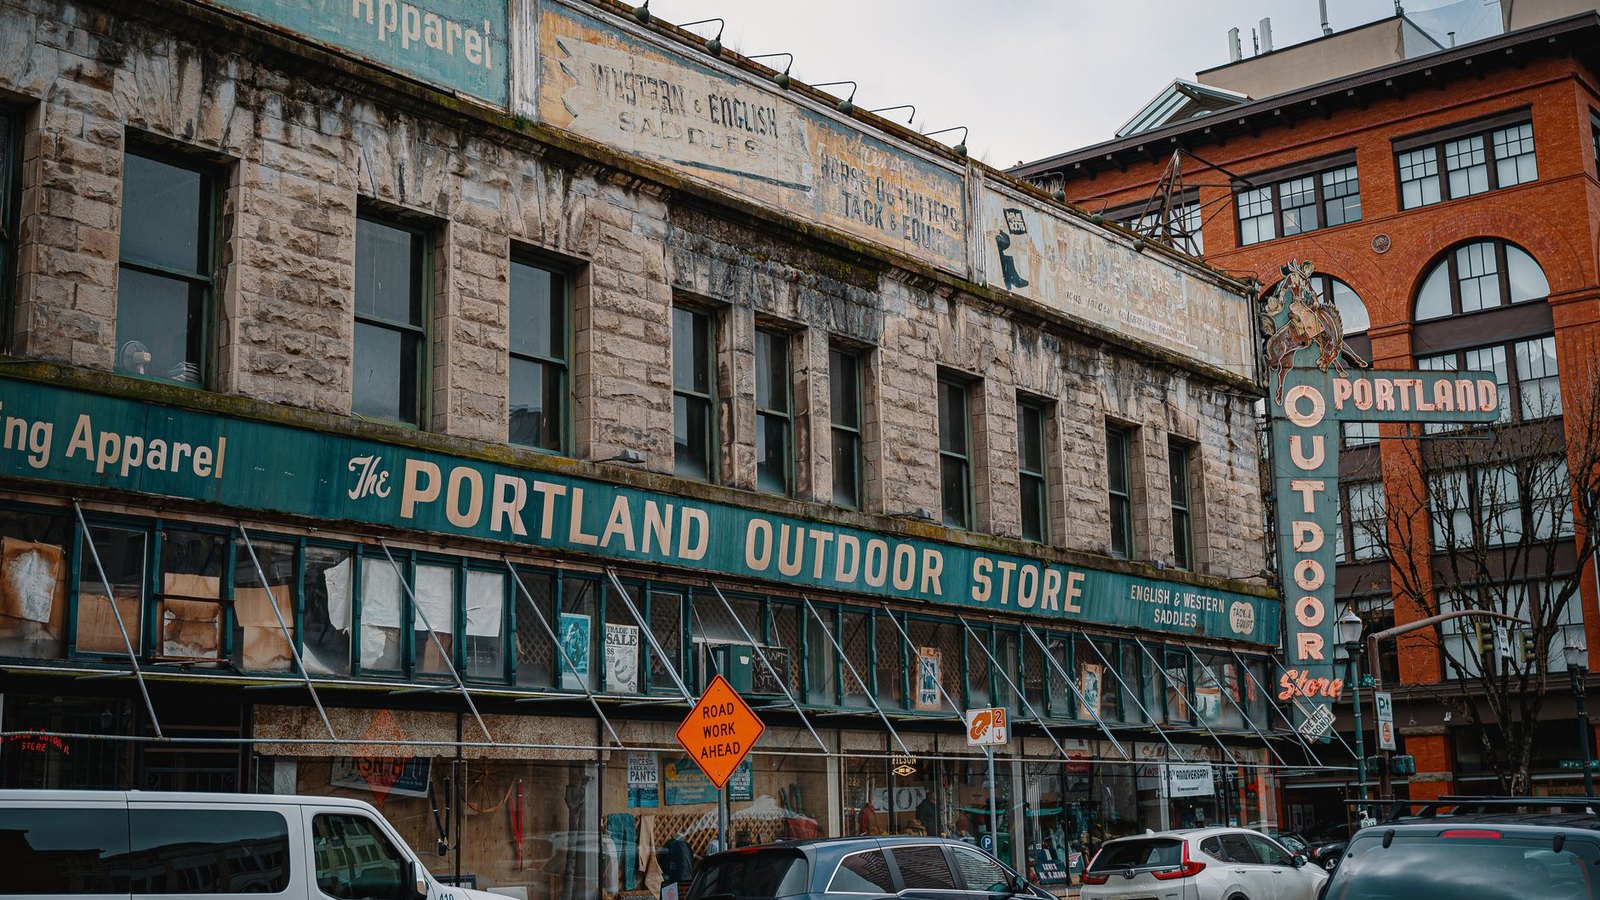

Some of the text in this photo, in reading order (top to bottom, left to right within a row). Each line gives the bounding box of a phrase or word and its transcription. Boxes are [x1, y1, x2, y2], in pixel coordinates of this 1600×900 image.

[707, 92, 778, 138] ENGLISH
[820, 151, 871, 196] HORSE
[842, 189, 885, 230] TACK
[1333, 378, 1498, 413] PORTLAND
[65, 413, 227, 479] Apparel
[347, 454, 1086, 614] The PORTLAND OUTDOOR STORE
[1283, 384, 1327, 661] OUTDOOR
[1130, 584, 1225, 614] ENGLISH & WESTERN
[607, 626, 637, 635] TRADE IN
[1153, 608, 1197, 628] SADDLES
[605, 632, 637, 647] SALE
[1278, 669, 1344, 701] Store
[702, 702, 735, 719] ROAD
[995, 710, 1002, 724] 2
[703, 722, 736, 739] WORK
[1300, 718, 1315, 735] THE
[700, 741, 741, 760] AHEAD
[629, 771, 656, 782] PANTS
